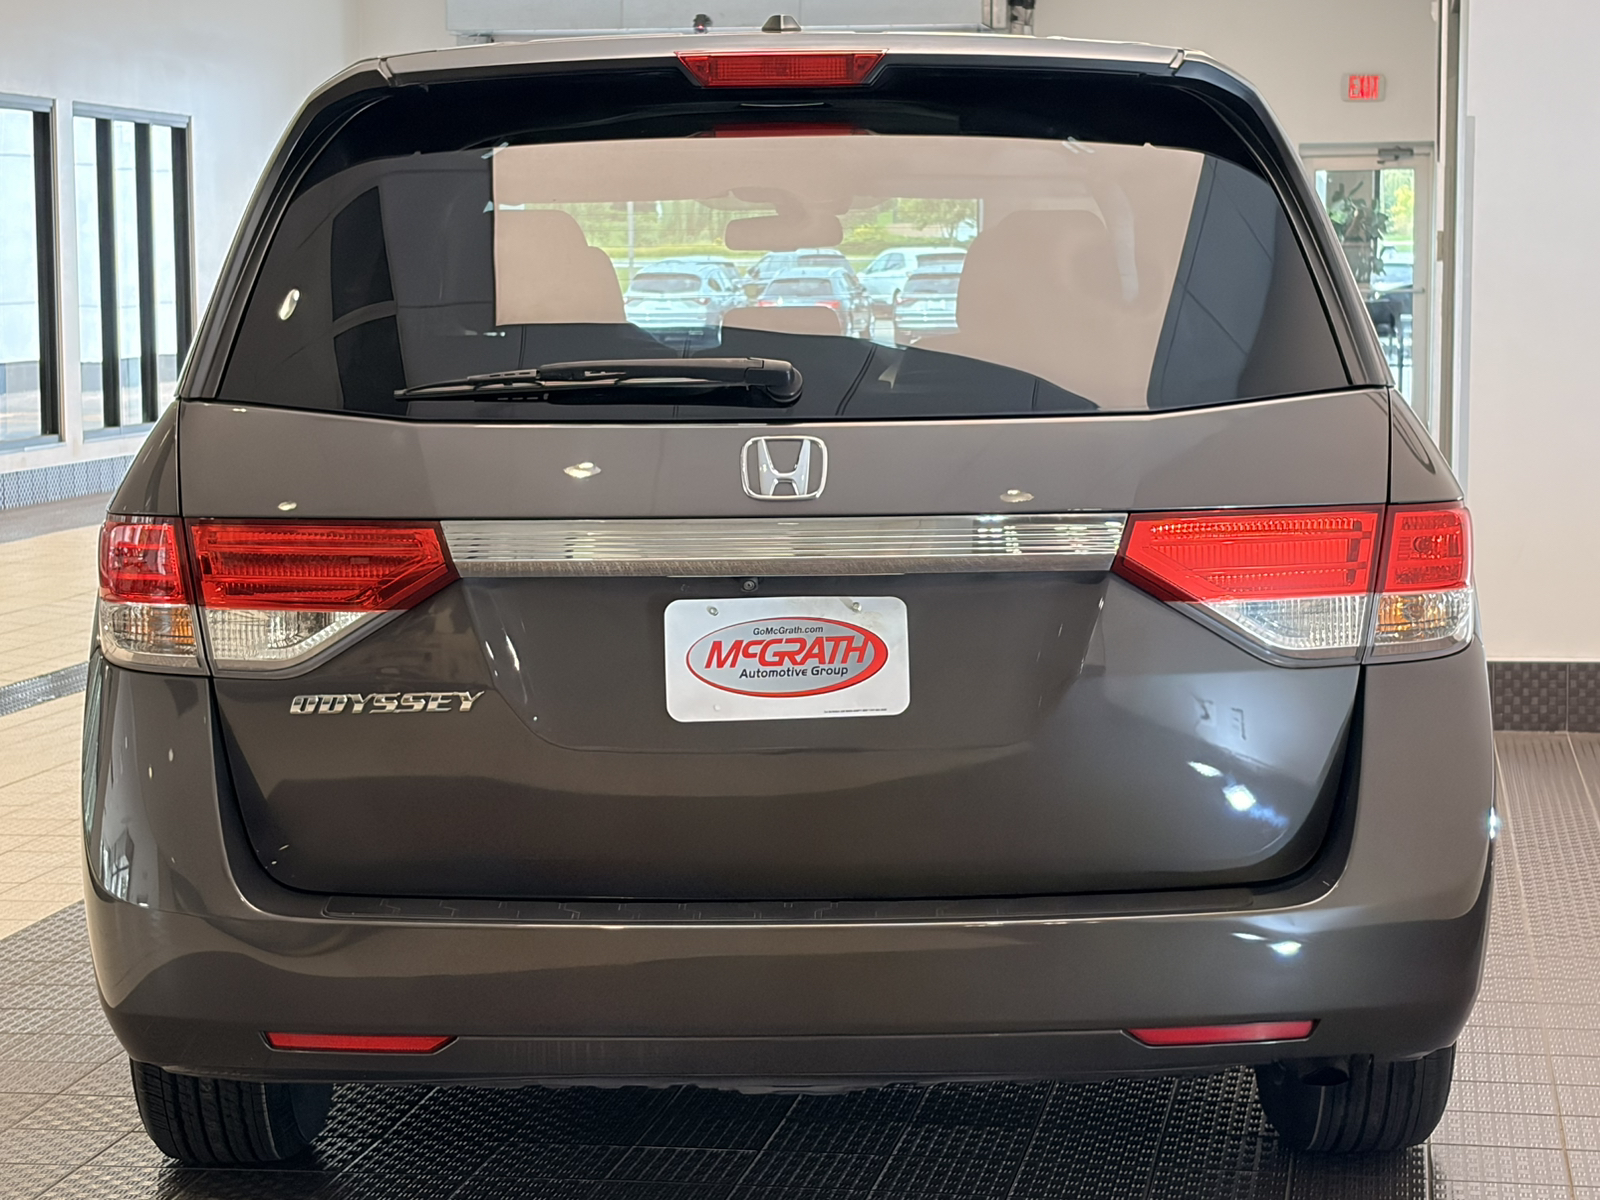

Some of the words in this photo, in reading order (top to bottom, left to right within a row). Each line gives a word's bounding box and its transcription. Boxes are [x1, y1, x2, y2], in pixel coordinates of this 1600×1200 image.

[1348, 74, 1379, 99] EXIT
[752, 625, 824, 636] GoMcGrath.com
[739, 667, 808, 679] Automotive
[811, 666, 849, 678] Group
[289, 690, 485, 714] ODYSSEY
